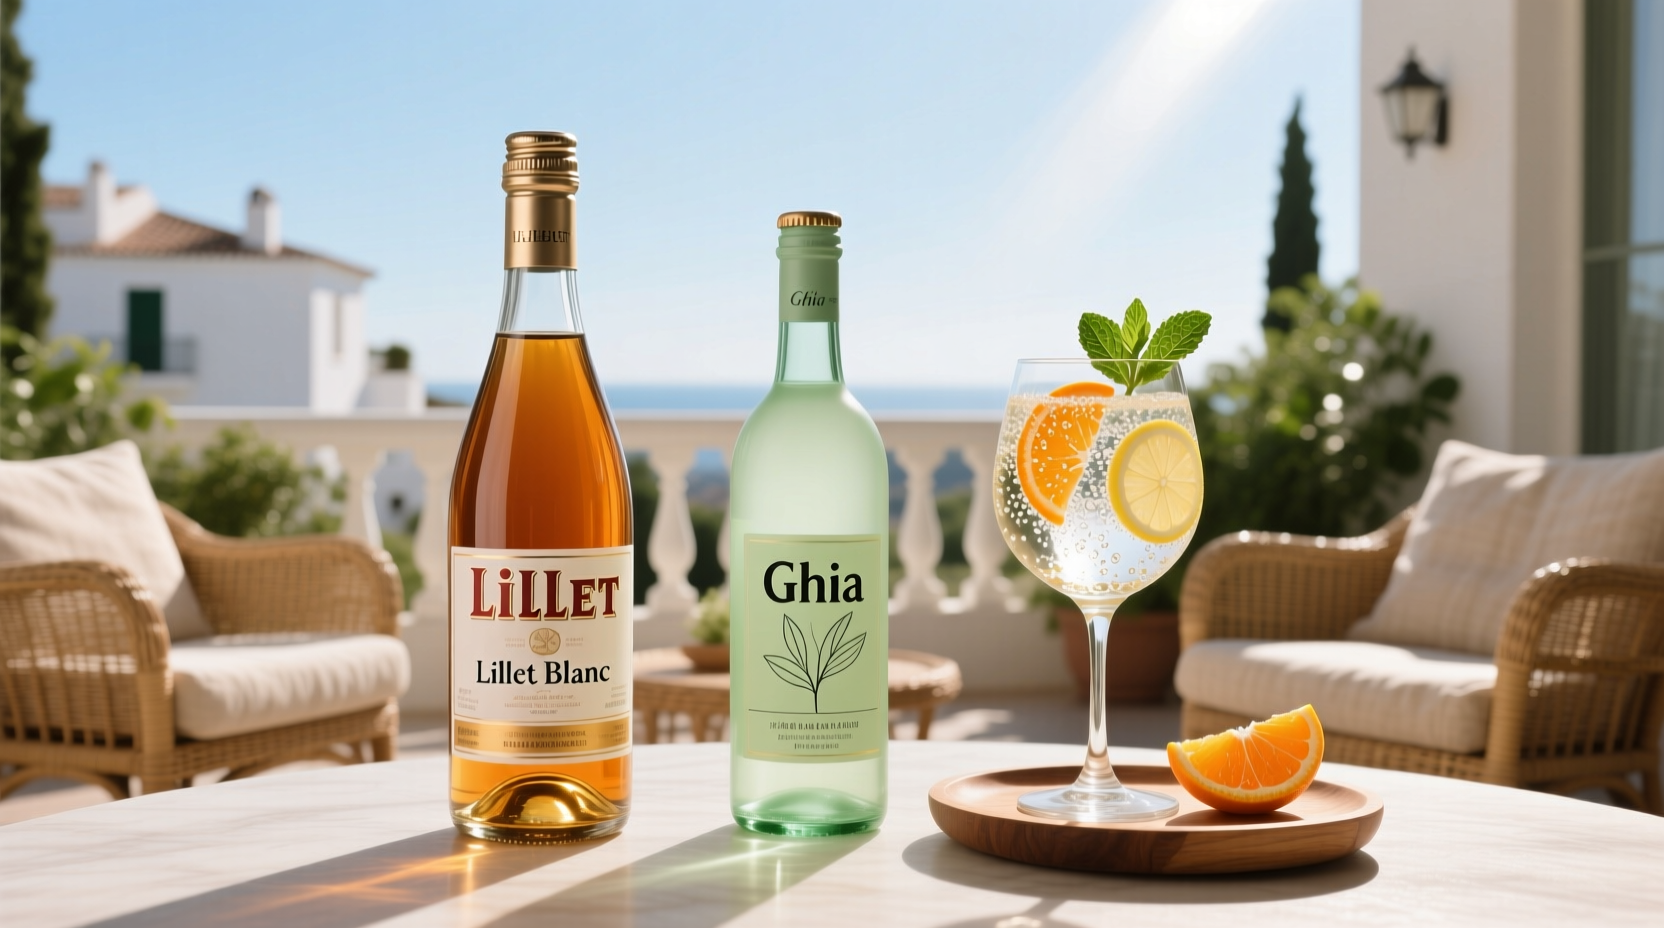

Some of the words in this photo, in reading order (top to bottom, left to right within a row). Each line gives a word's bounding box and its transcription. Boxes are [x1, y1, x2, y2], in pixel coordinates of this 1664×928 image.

[763, 560, 865, 604] Ghia
[476, 660, 538, 685] Lillet
[544, 660, 611, 685] Blanc
